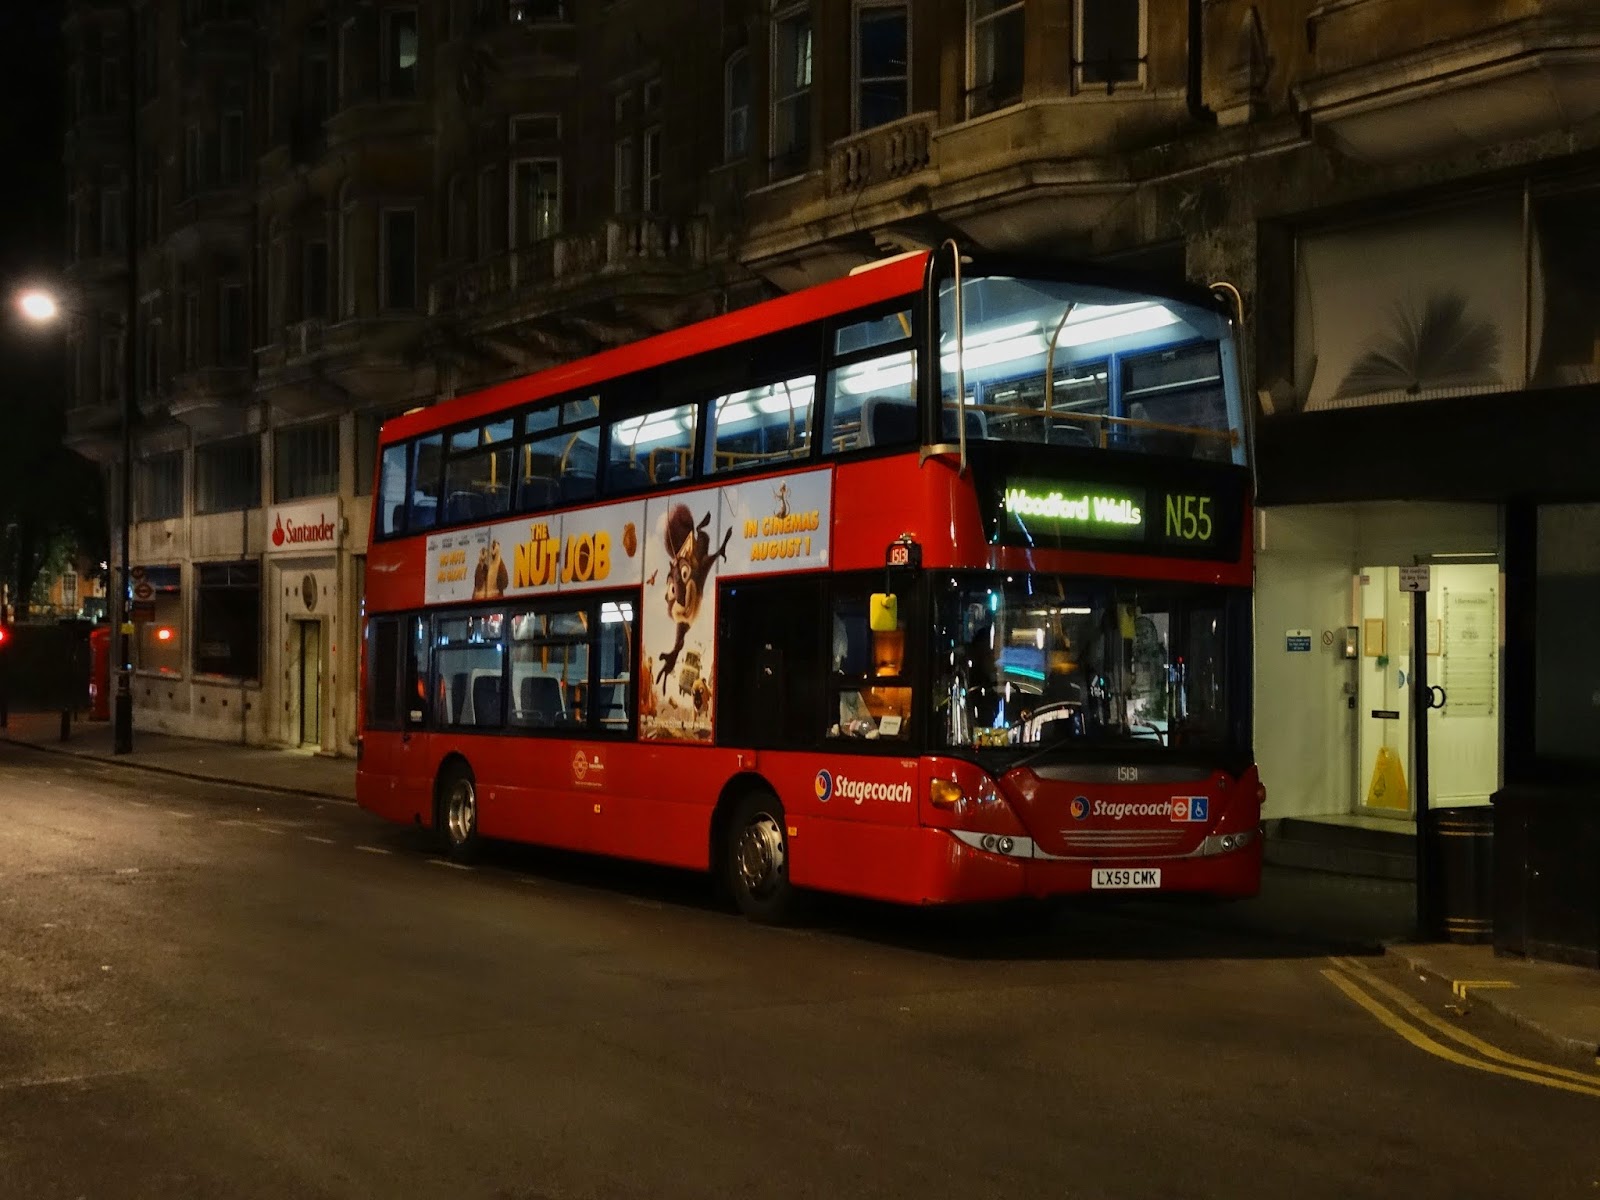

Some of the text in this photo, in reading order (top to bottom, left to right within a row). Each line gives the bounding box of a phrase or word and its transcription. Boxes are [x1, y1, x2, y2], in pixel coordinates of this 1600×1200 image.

[1005, 488, 1090, 521] Woodford
[1166, 493, 1212, 541] N55
[286, 512, 335, 544] Santander
[530, 522, 549, 541] THE
[743, 510, 820, 539] IN CINEMAS
[512, 530, 612, 589] NUT JOB
[750, 535, 812, 562] AUGUST 1
[1118, 766, 1138, 781] 15131
[834, 774, 912, 806] Stagecoach
[1092, 799, 1172, 820] Stagecoach
[1097, 871, 1157, 886] LX59 CMK
